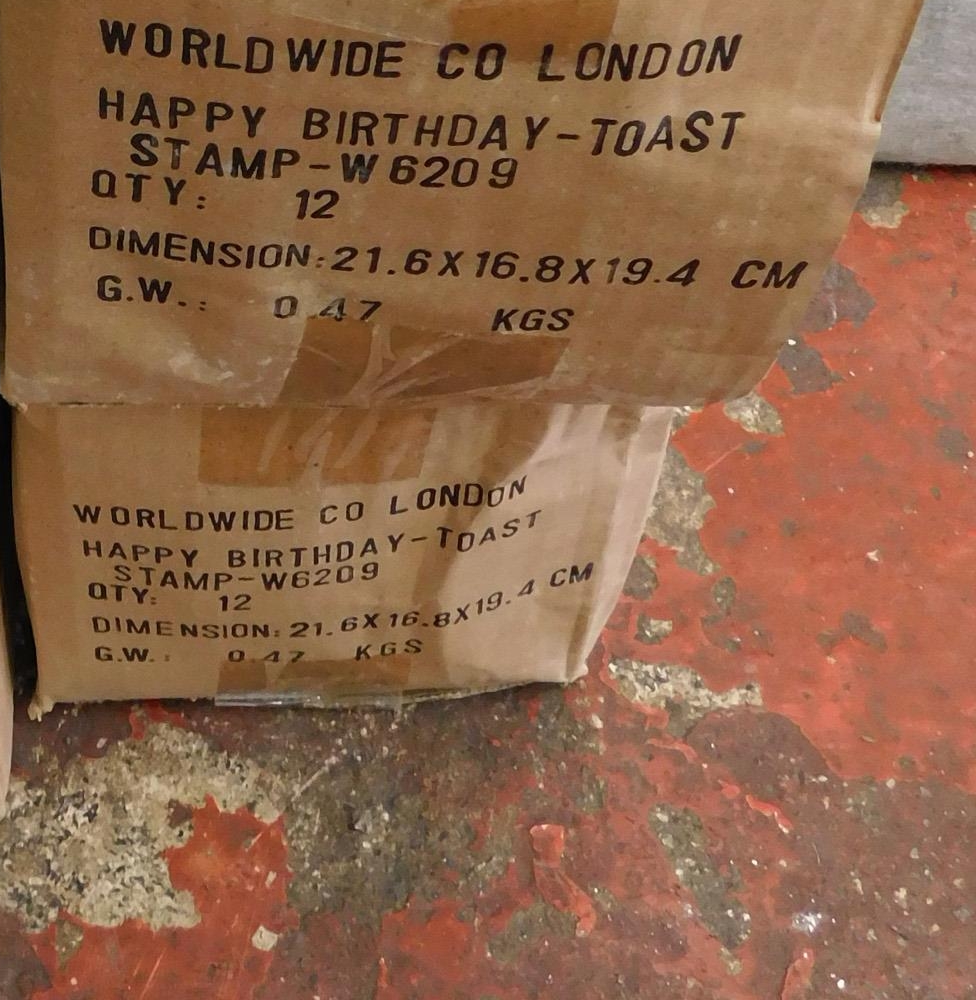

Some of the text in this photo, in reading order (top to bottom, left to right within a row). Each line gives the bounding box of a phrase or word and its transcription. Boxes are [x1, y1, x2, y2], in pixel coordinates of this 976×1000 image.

[99, 19, 742, 81] WORLDWIDE CO LONDON
[99, 88, 266, 138] HAPPY
[91, 171, 340, 220] QTY: 12
[731, 260, 808, 289] CM
[491, 308, 574, 332] KGS
[73, 476, 528, 533] WORLDWIDE CO LONDON
[82, 539, 199, 567] HAPPY
[550, 562, 594, 588] CM
[88, 581, 252, 613] QTY: 12
[355, 638, 423, 662] KGS
